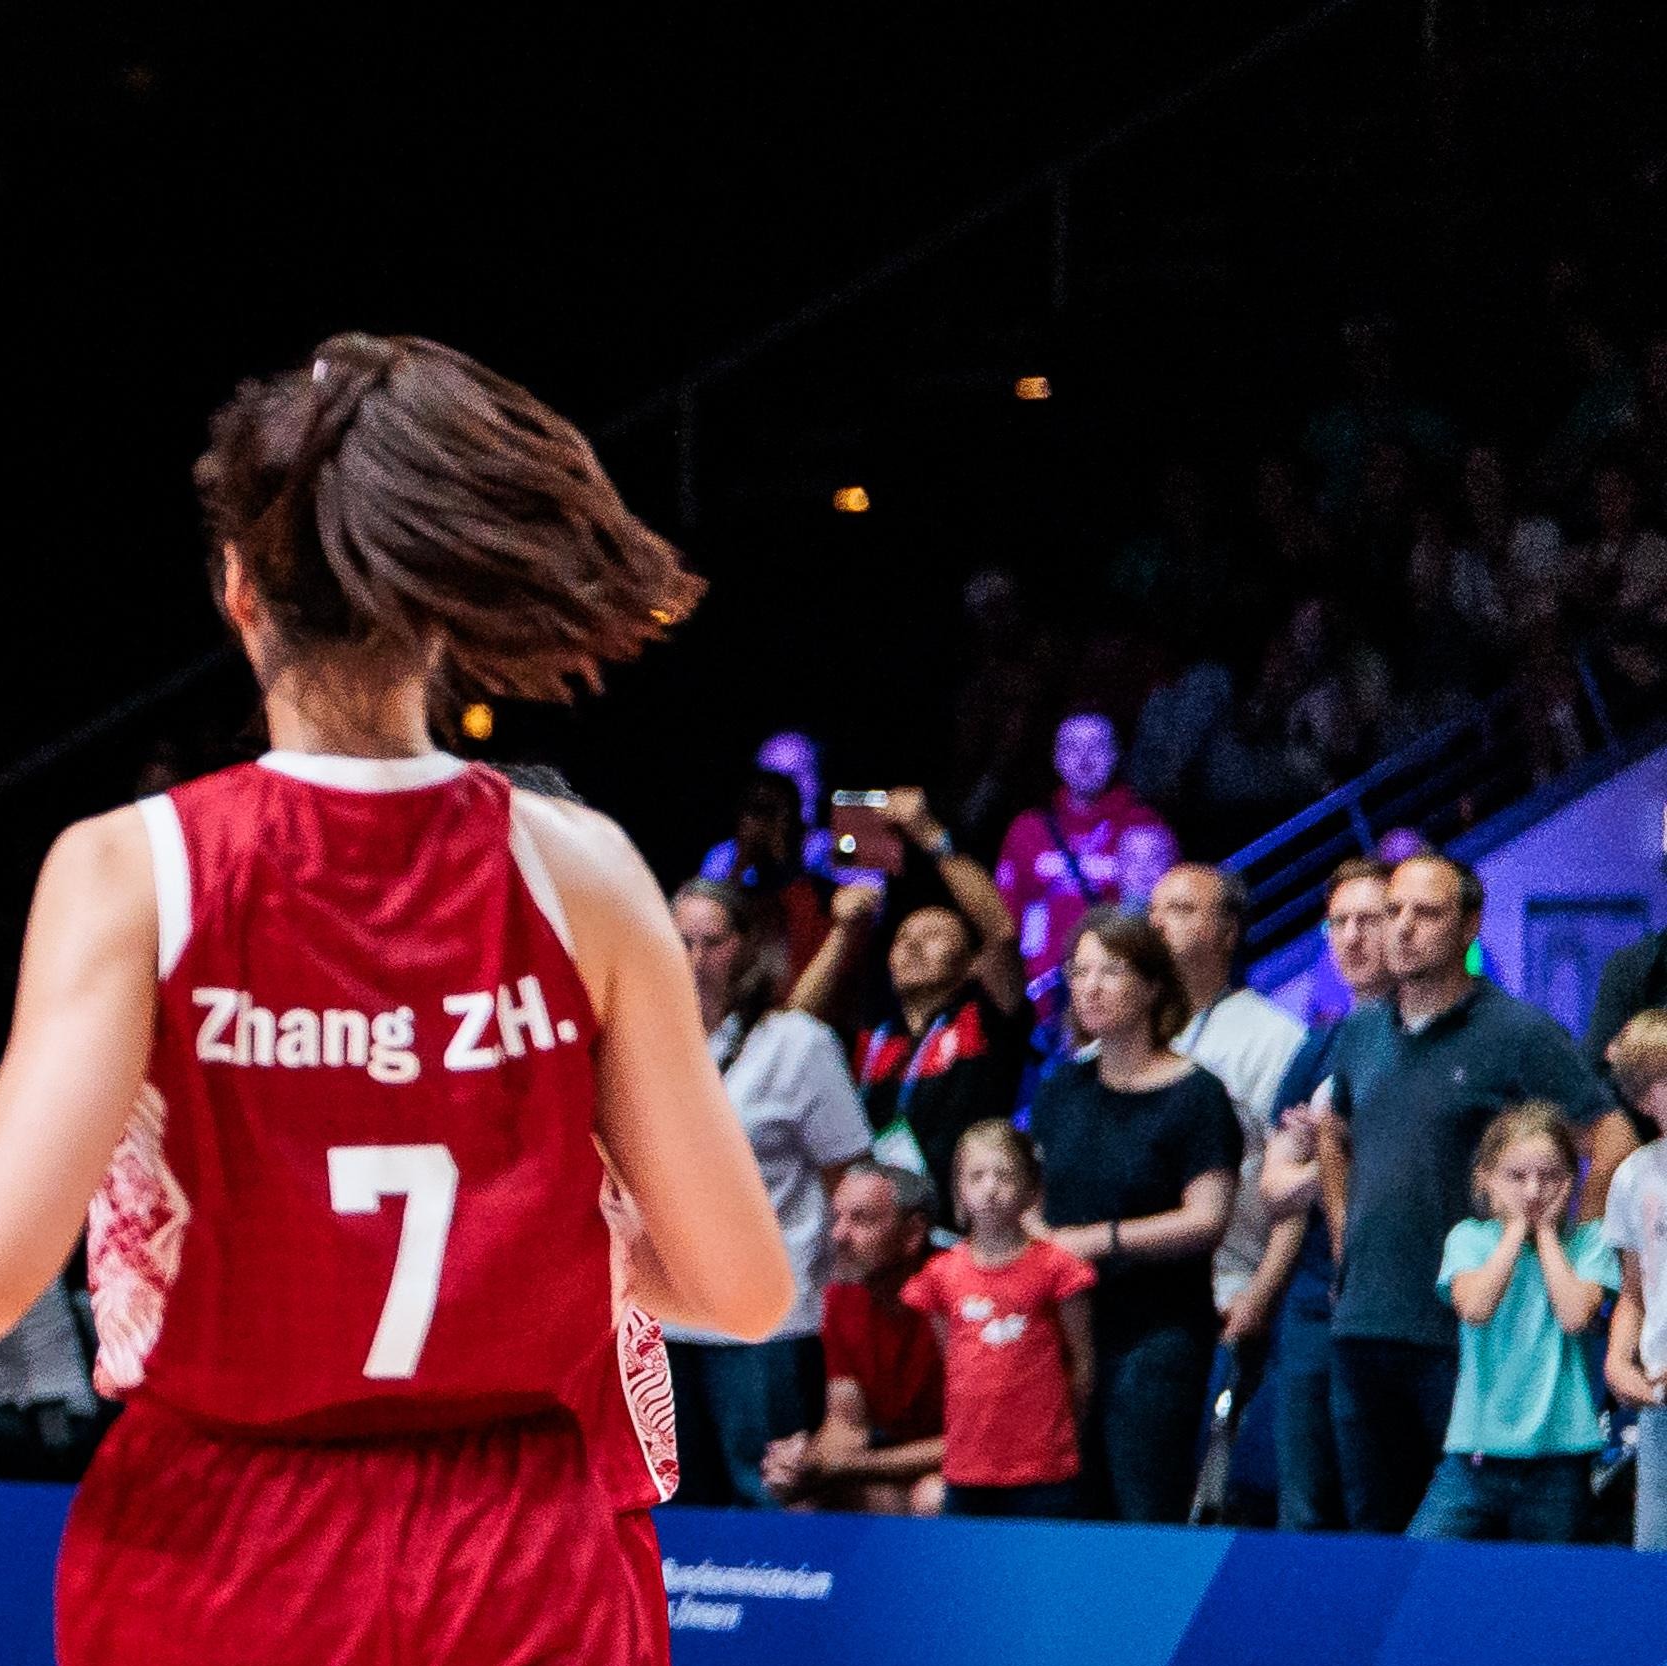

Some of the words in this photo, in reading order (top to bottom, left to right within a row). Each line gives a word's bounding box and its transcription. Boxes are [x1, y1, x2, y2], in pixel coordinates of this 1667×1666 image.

[192, 986, 421, 1084] Zhang
[443, 974, 578, 1071] ZH.
[326, 1143, 459, 1380] 7
